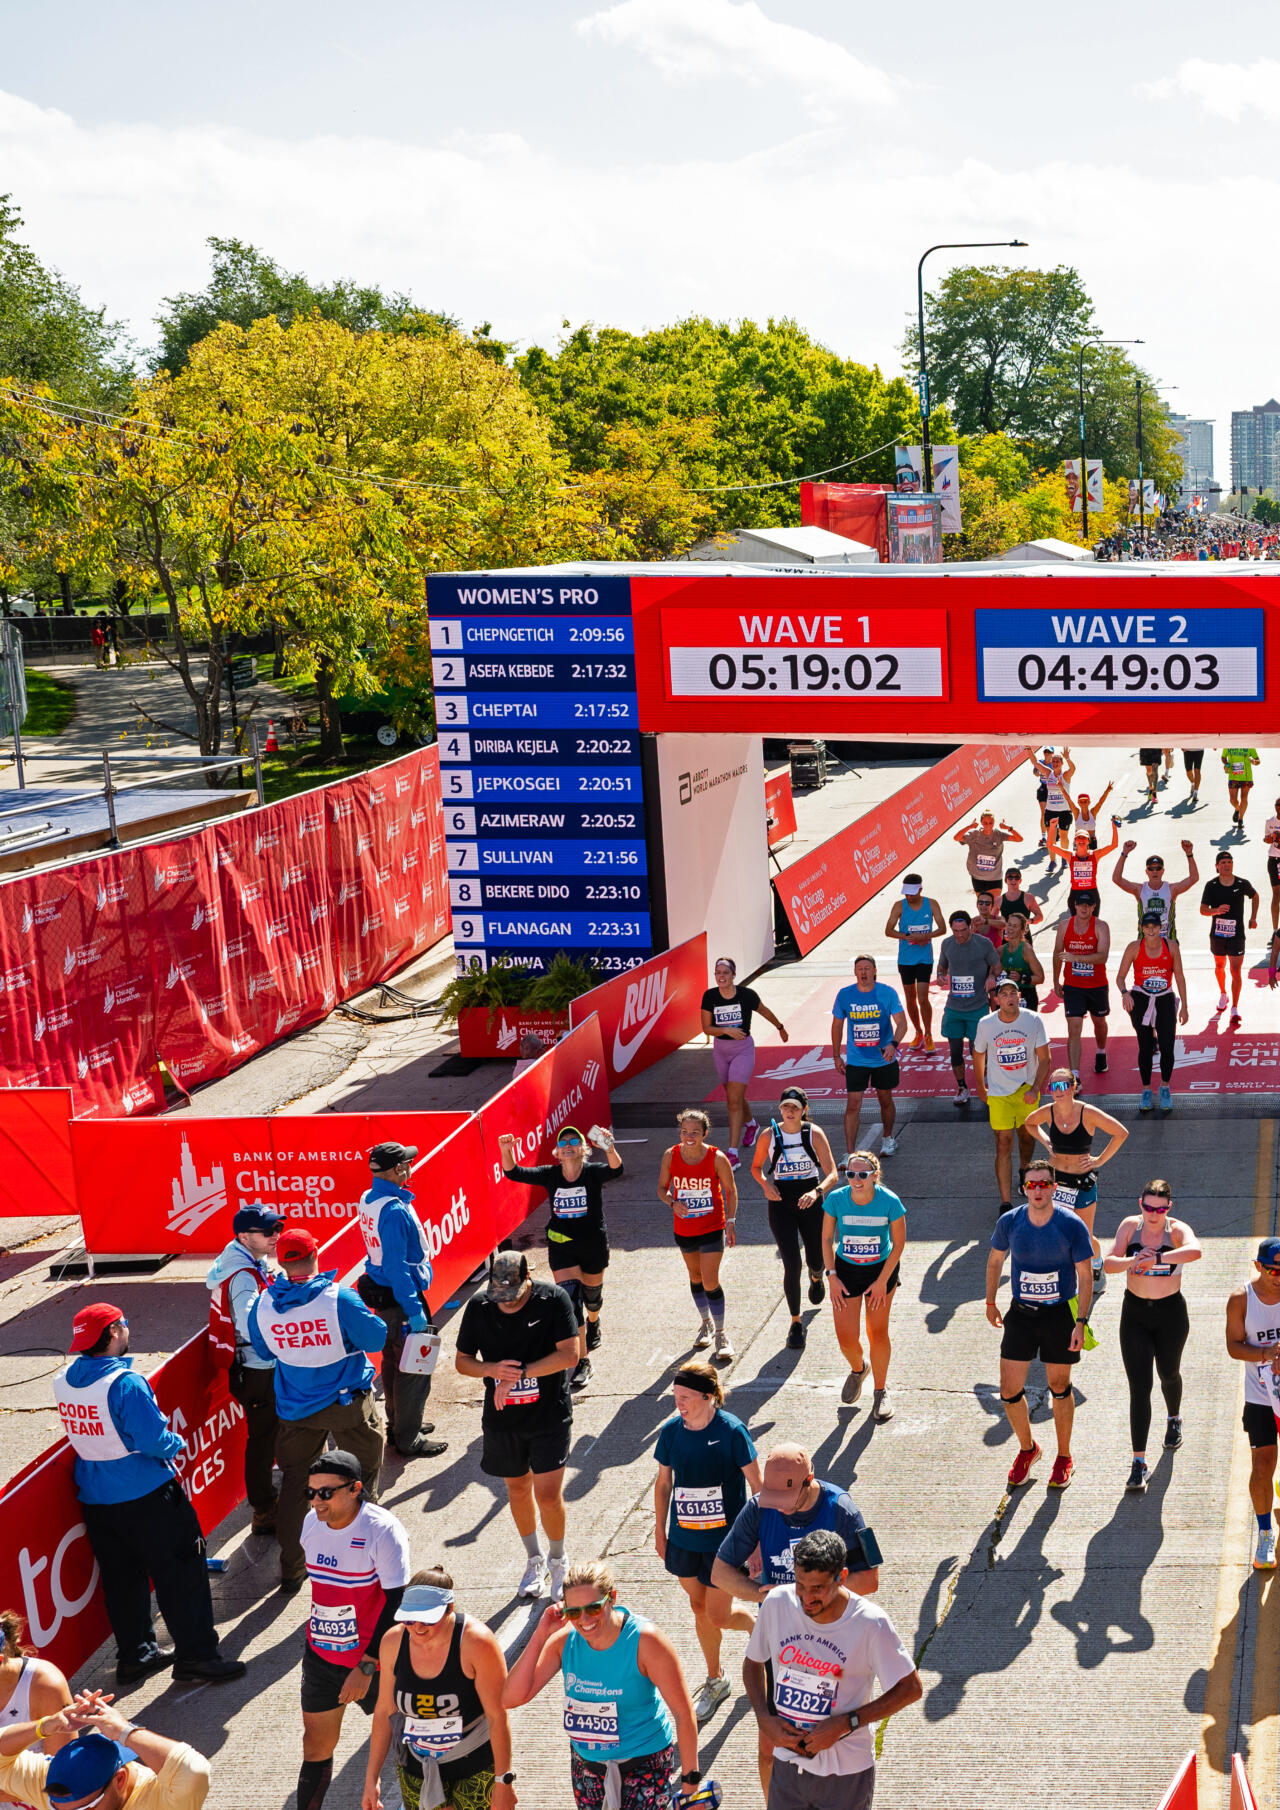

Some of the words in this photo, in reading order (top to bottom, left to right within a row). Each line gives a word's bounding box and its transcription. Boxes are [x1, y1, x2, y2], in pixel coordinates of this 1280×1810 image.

[559, 588, 599, 605] PRO
[441, 626, 450, 645] 1
[466, 627, 554, 642] CHEPNGETICH
[568, 627, 625, 642] 2:09:56
[739, 615, 844, 643] WAVE
[858, 615, 871, 643] 1
[1051, 615, 1157, 643] WAVE
[1169, 615, 1189, 643] 2
[441, 662, 455, 681] 2
[469, 664, 507, 679] ASEFA
[508, 664, 555, 679] KEBEDE
[571, 664, 627, 679] 2:17:32
[708, 653, 902, 692] 05:19:02
[1017, 653, 1221, 692] 04:49:03
[445, 702, 458, 721] 3
[472, 703, 538, 717] CHEPTAI
[574, 703, 630, 718] 2:17:52
[447, 738, 461, 756] 4
[474, 739, 514, 754] DIRIBA
[516, 739, 559, 756] KEJELA
[575, 739, 632, 754] 2:20:22
[450, 776, 463, 794] 5
[476, 777, 561, 793] JEPKOSGEI
[578, 777, 632, 791] 2:20:51
[452, 812, 466, 830] 6
[480, 814, 566, 828] AZIMERAW
[580, 814, 637, 828] 2:20:52
[455, 849, 467, 867] 7
[483, 850, 554, 864] SULLIVAN
[583, 850, 639, 865] 2:21:56
[458, 883, 472, 902] 8
[485, 885, 535, 899] BEKERE
[538, 885, 570, 899] DIDO
[585, 885, 641, 900] 2:23:10
[461, 920, 474, 938] 9
[488, 922, 572, 936] FLANAGAN
[588, 922, 641, 936] 2:23:31
[491, 956, 544, 970] NDIWA
[621, 965, 671, 1032] RUN
[850, 1003, 878, 1012] Team
[849, 1011, 881, 1020] RMHC
[995, 1036, 1026, 1048] Chicago
[526, 1123, 544, 1151] OF
[545, 1084, 584, 1140] AMERICA
[233, 1151, 274, 1163] BANK
[278, 1151, 295, 1162] OF
[297, 1150, 364, 1162] AMERICA
[235, 1169, 336, 1199] Chicago
[852, 1244, 879, 1254] 39941
[1028, 1283, 1059, 1294] 45351
[270, 1318, 329, 1337] CODE
[273, 1333, 332, 1350] TEAM
[58, 1401, 101, 1421] CODE
[61, 1418, 105, 1437] TEAM
[175, 1400, 245, 1472] SULTAN
[686, 1499, 724, 1515] 61435
[316, 1553, 338, 1569] Bob
[318, 1620, 357, 1635] 46934
[779, 1634, 803, 1648] BANK
[803, 1633, 815, 1642] OF
[816, 1636, 848, 1664] AMERICA
[779, 1645, 842, 1678] Chicago
[574, 1684, 623, 1697] Champions
[782, 1687, 831, 1714] 32827
[576, 1714, 619, 1732] 44503
